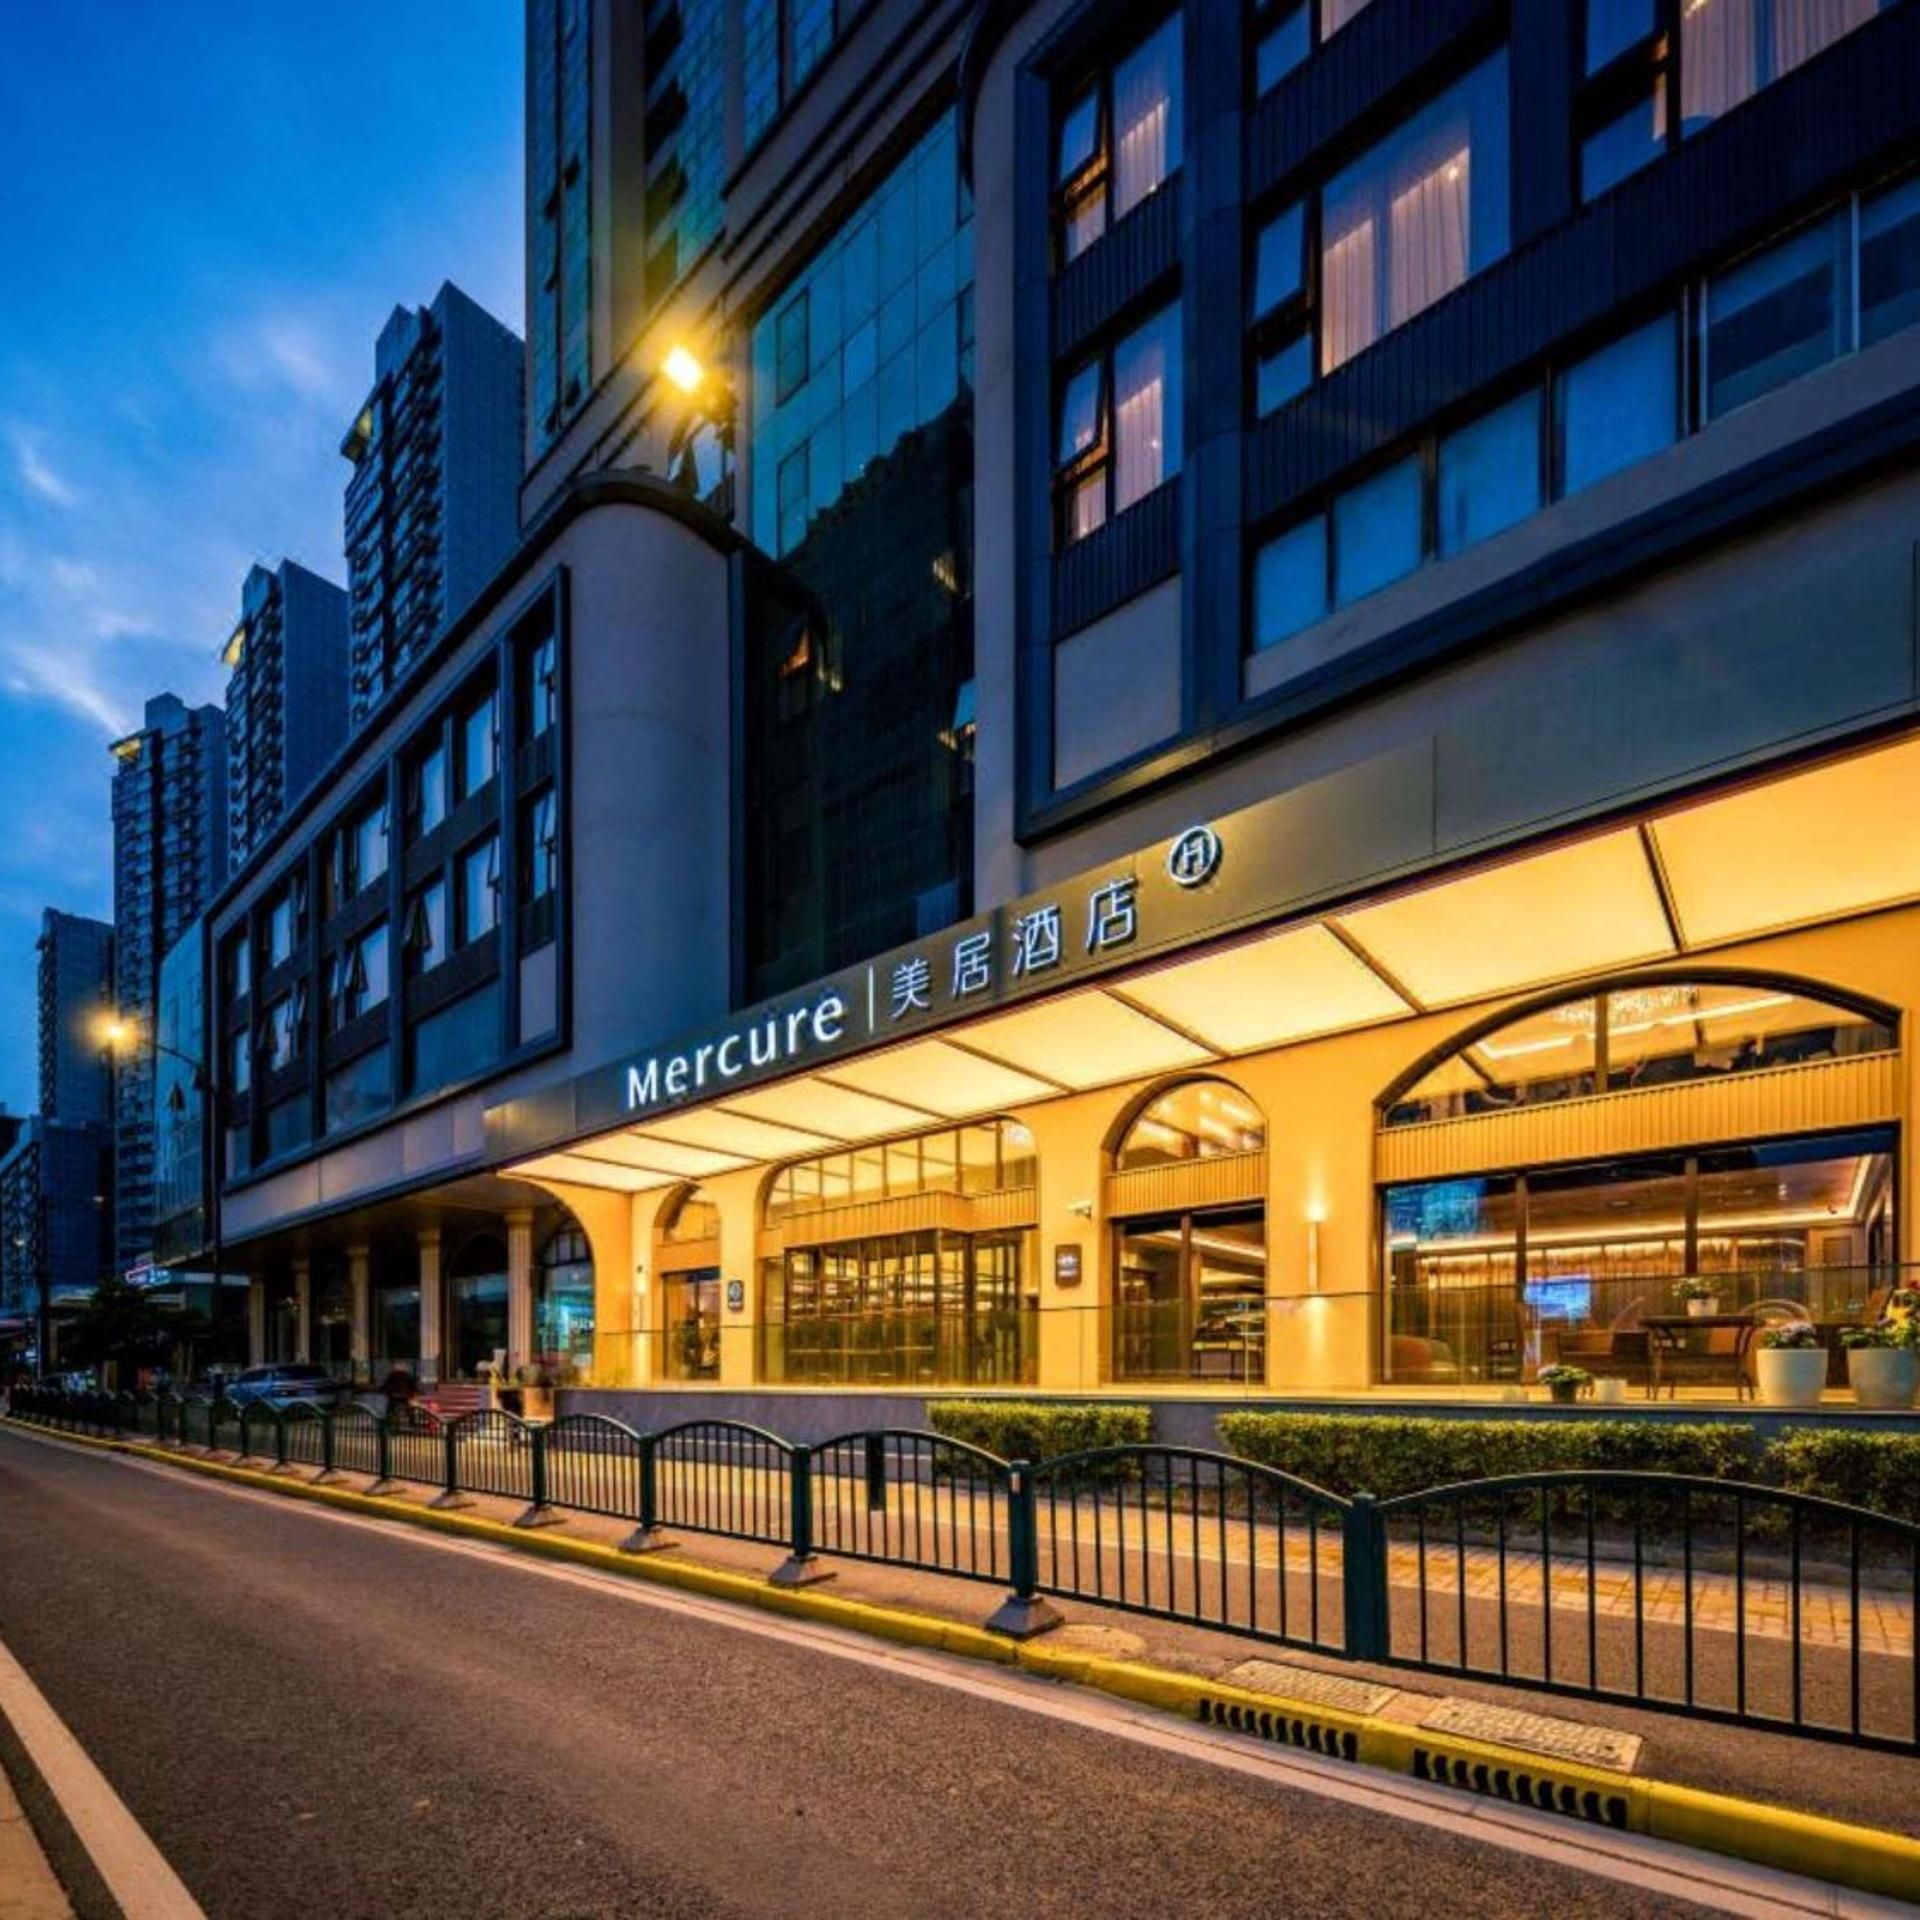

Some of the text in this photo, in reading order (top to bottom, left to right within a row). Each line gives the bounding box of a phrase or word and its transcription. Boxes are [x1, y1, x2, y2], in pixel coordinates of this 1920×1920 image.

[889, 877, 1137, 1018] 美居酒店
[628, 996, 844, 1110] Mercure
